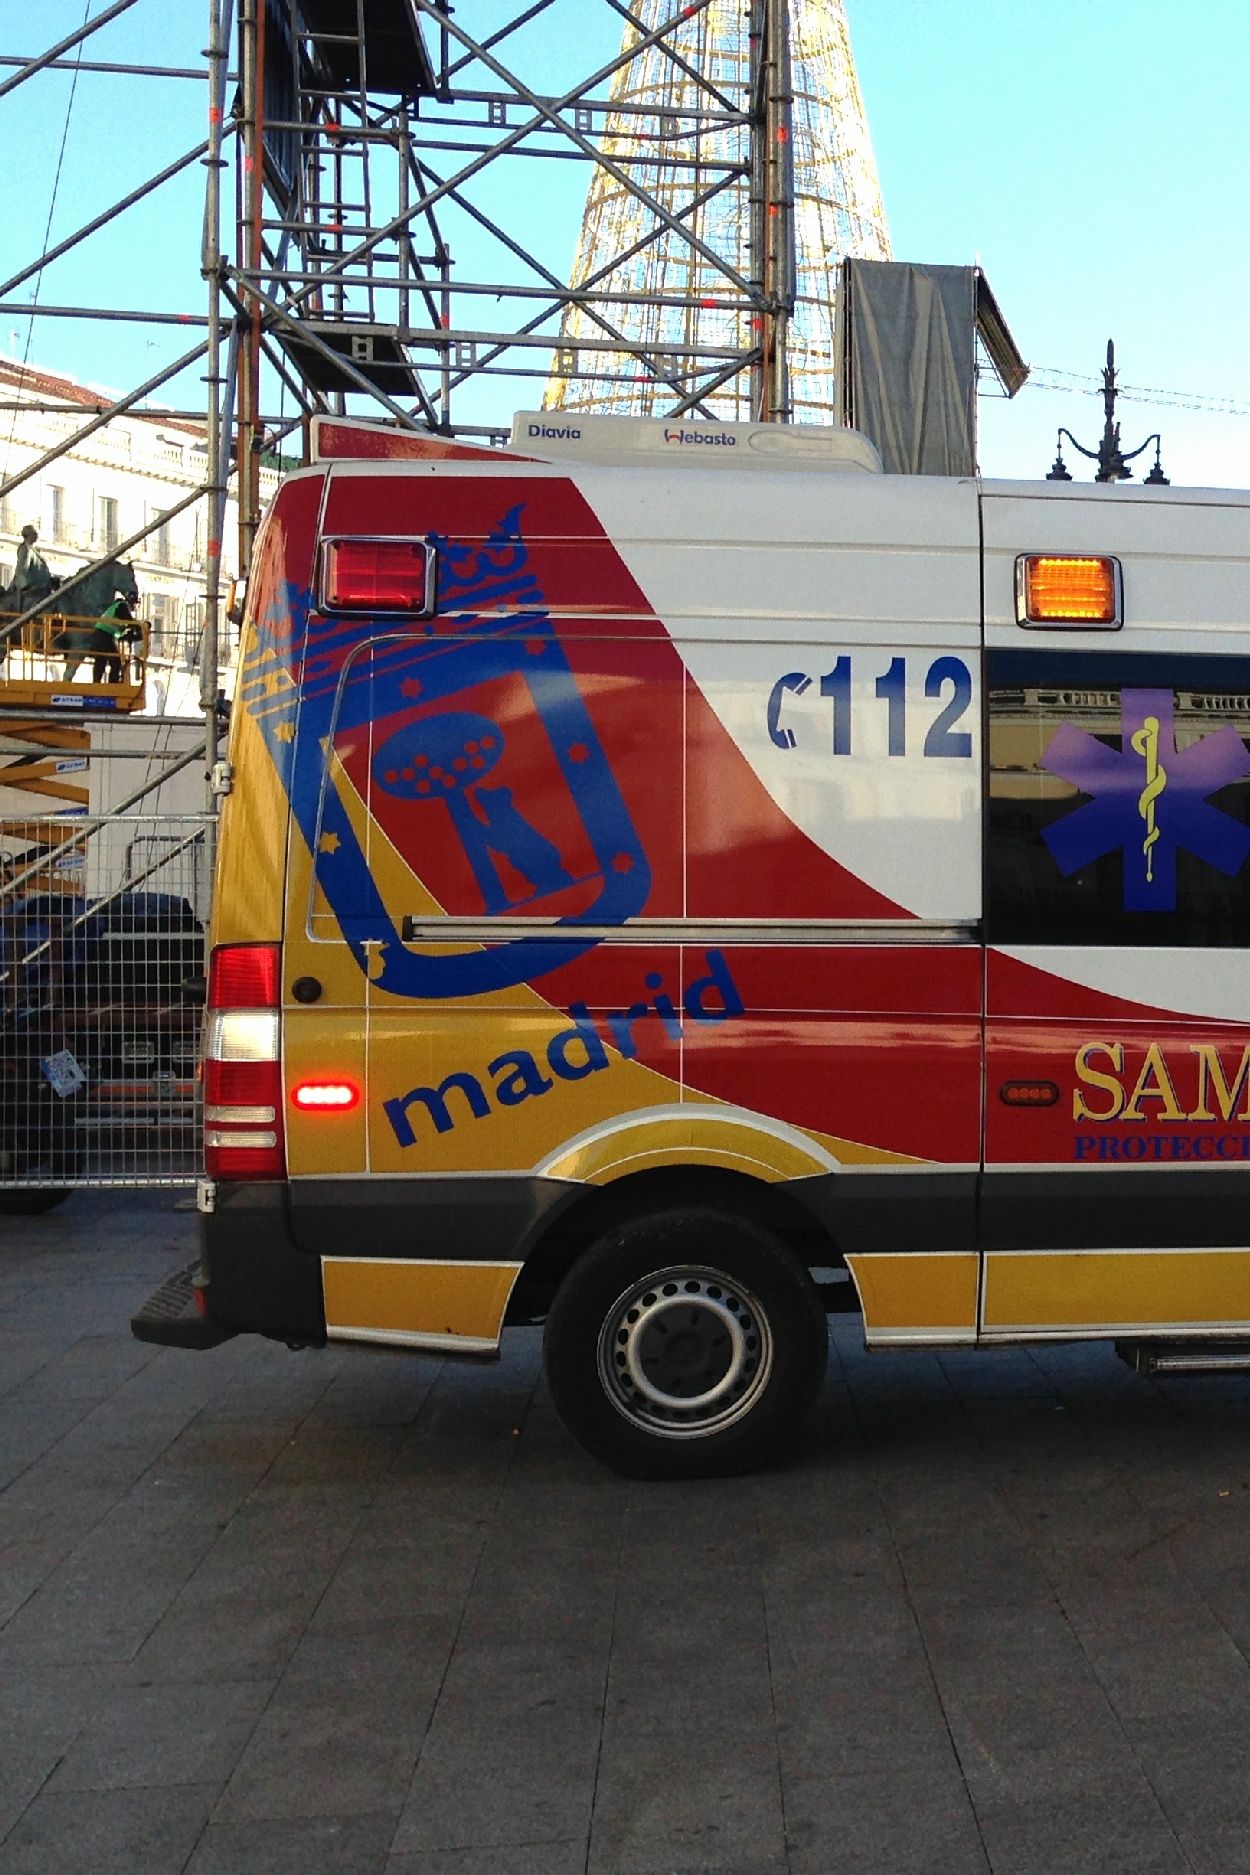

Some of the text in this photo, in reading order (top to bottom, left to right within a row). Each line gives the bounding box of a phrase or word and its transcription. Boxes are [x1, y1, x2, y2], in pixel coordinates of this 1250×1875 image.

[528, 424, 581, 440] Diavia
[664, 428, 736, 446] Webasto
[820, 656, 972, 758] 112
[383, 949, 746, 1148] madrid
